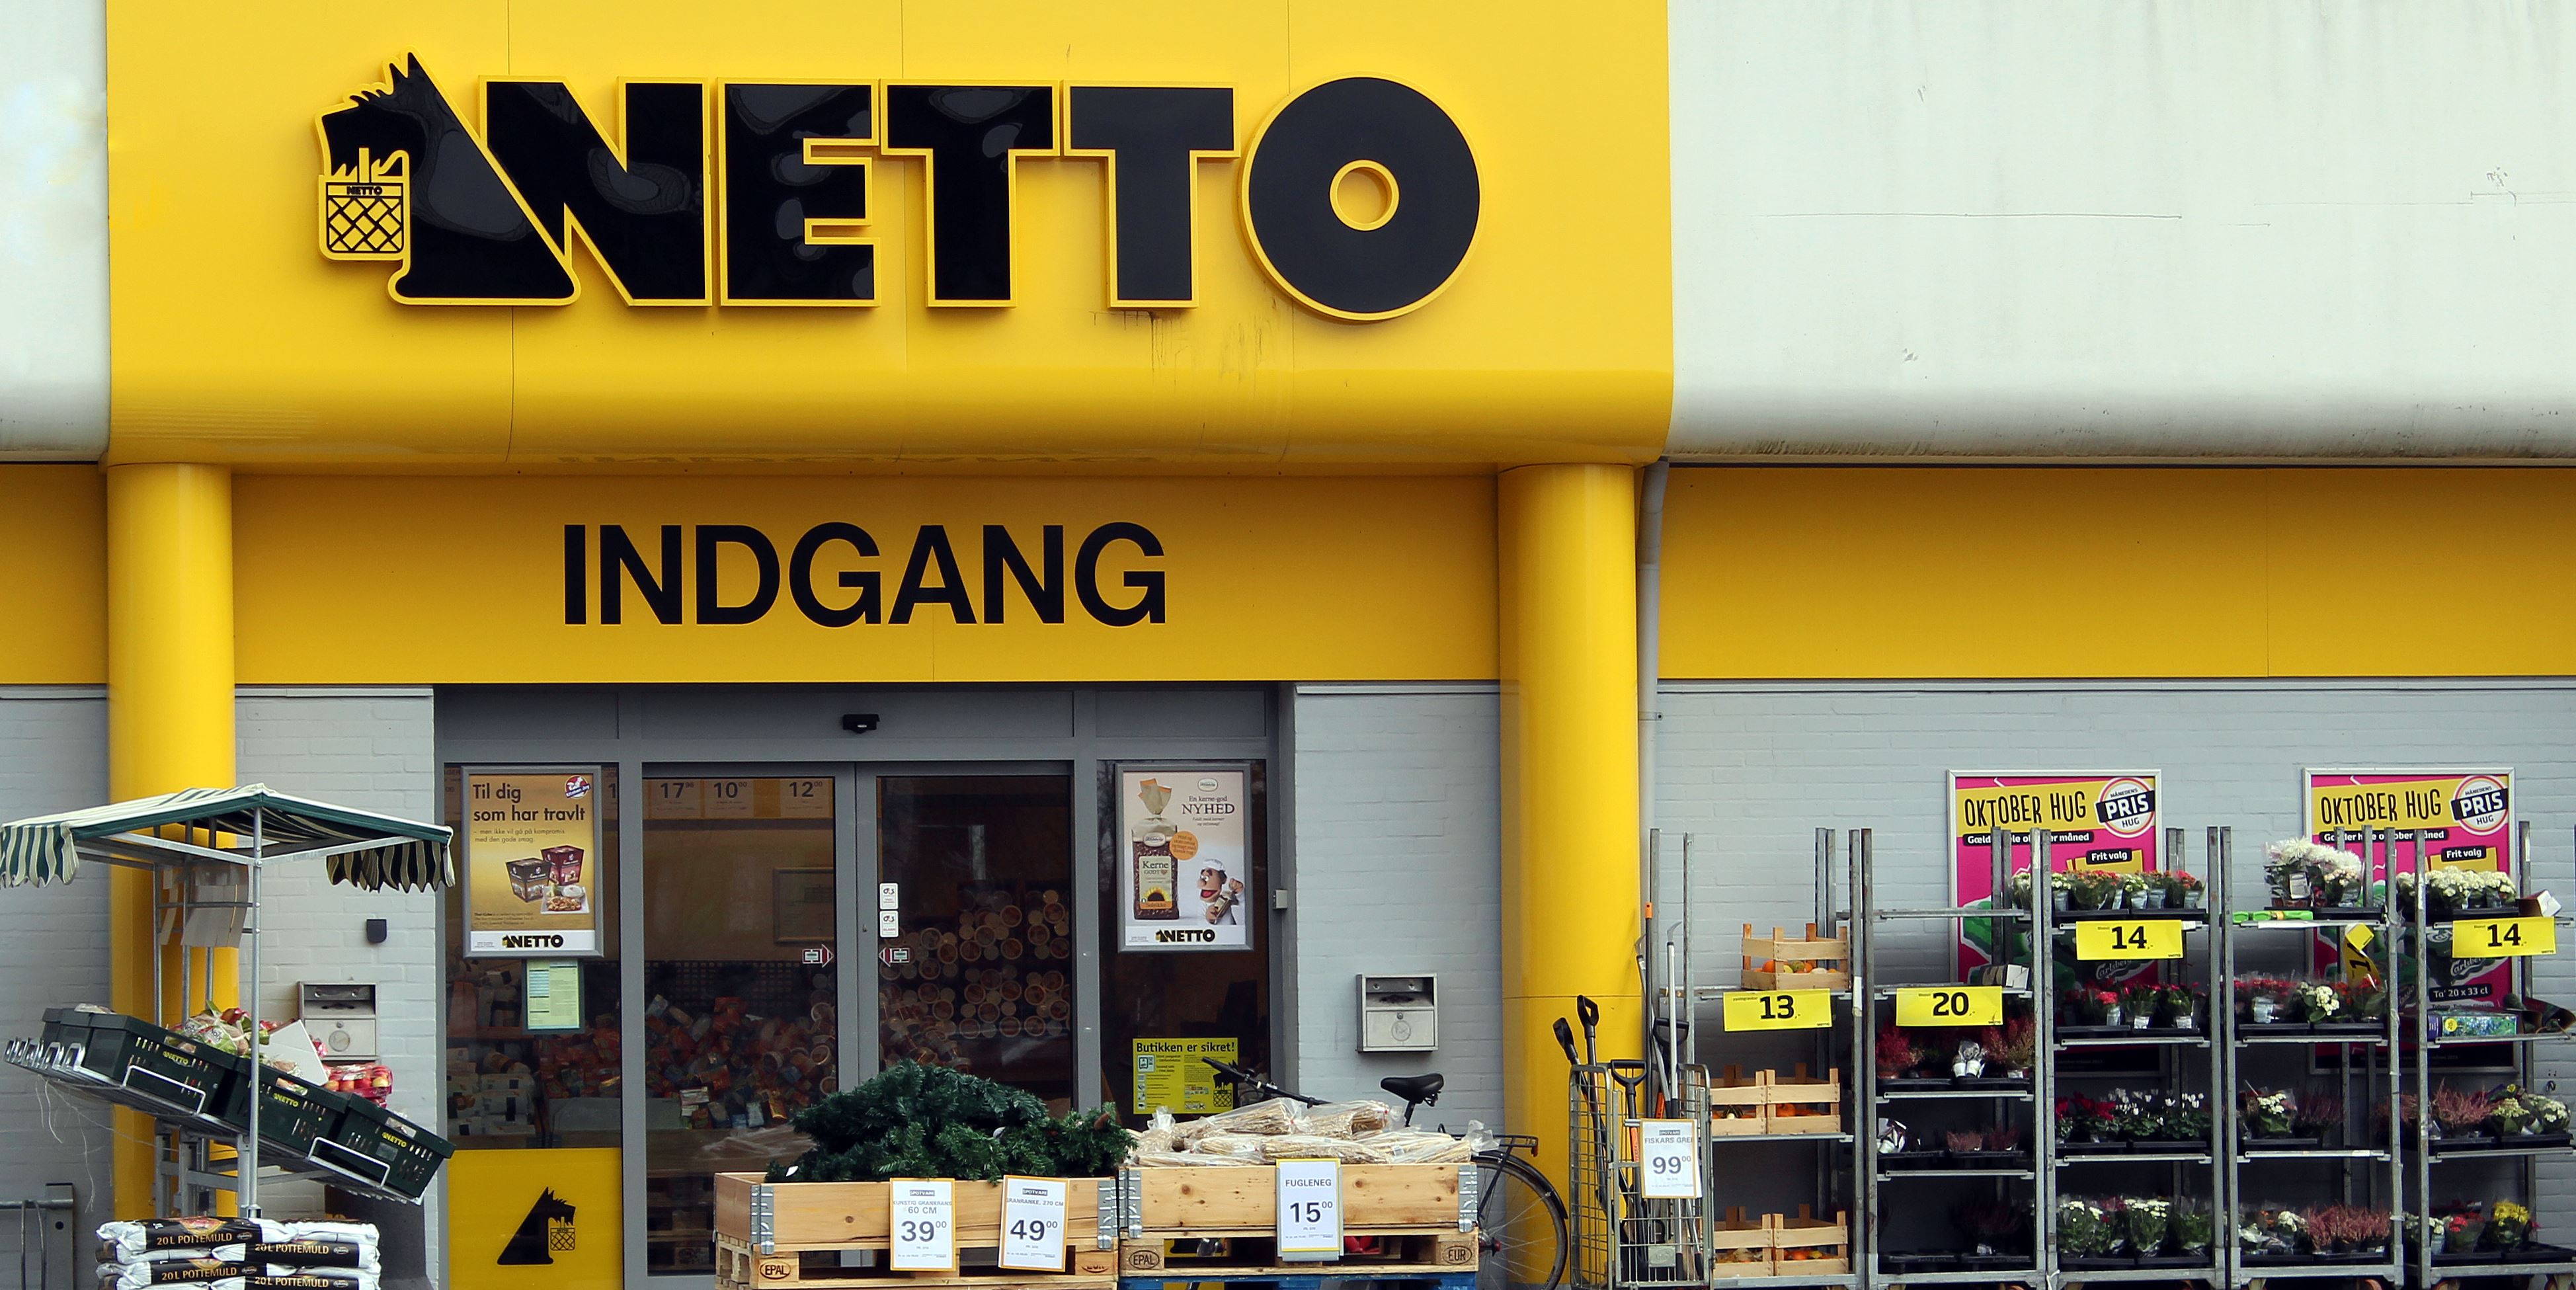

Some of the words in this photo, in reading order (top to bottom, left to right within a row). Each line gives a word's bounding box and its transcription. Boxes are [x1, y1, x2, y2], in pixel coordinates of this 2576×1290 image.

[483, 74, 1482, 319] NETTO
[565, 521, 1166, 626] INDGANG
[473, 783, 490, 799] Til
[497, 783, 521, 803] dig
[661, 782, 684, 798] 17
[713, 782, 739, 798] 10
[789, 782, 814, 797] 12
[2111, 788, 2138, 797] MÅNEDENS
[2465, 786, 2492, 795] MÅNEDENS
[1182, 803, 1235, 814] NYHED
[1964, 795, 2042, 826] OKTOBER
[2050, 791, 2086, 822] HUG
[2105, 794, 2149, 819] PRIS
[2321, 793, 2397, 825] OKTOBER
[2405, 789, 2441, 820] HUG
[2460, 791, 2503, 817] PRIS
[473, 810, 505, 821] som
[512, 805, 538, 821] har
[544, 805, 585, 821] travlt
[2476, 815, 2494, 825] HUG
[2122, 817, 2140, 828] HUG
[2059, 832, 2089, 842] måned
[2091, 852, 2108, 861] Frit
[2109, 851, 2127, 860] valg
[2446, 850, 2462, 858] Frit
[2463, 848, 2482, 857] valg
[510, 934, 564, 948] NETTO
[1166, 929, 1215, 942] NETTO
[1137, 1043, 1182, 1052] Butikken
[1201, 1042, 1234, 1052] sikret!
[167, 1052, 188, 1065] NETTO
[277, 1094, 298, 1108] NETTO
[386, 1133, 407, 1148] NETTO
[1652, 1156, 1681, 1174] 99
[1290, 1202, 1321, 1223] 15
[901, 1221, 934, 1242] 39
[1010, 1220, 1045, 1241] 49
[157, 1237, 168, 1246] 20
[179, 1233, 232, 1244] POTTEMULD
[276, 1244, 329, 1254] POTTEMULD
[1449, 1249, 1466, 1261] EUR
[1133, 1255, 1154, 1266] EPAL
[161, 1271, 173, 1281] 20
[175, 1271, 180, 1279] L
[183, 1267, 237, 1279] POTTEMULD
[765, 1264, 787, 1275] EPAL
[255, 1276, 266, 1285] 20
[268, 1277, 272, 1285] L
[276, 1277, 329, 1287] POTTEMULD
